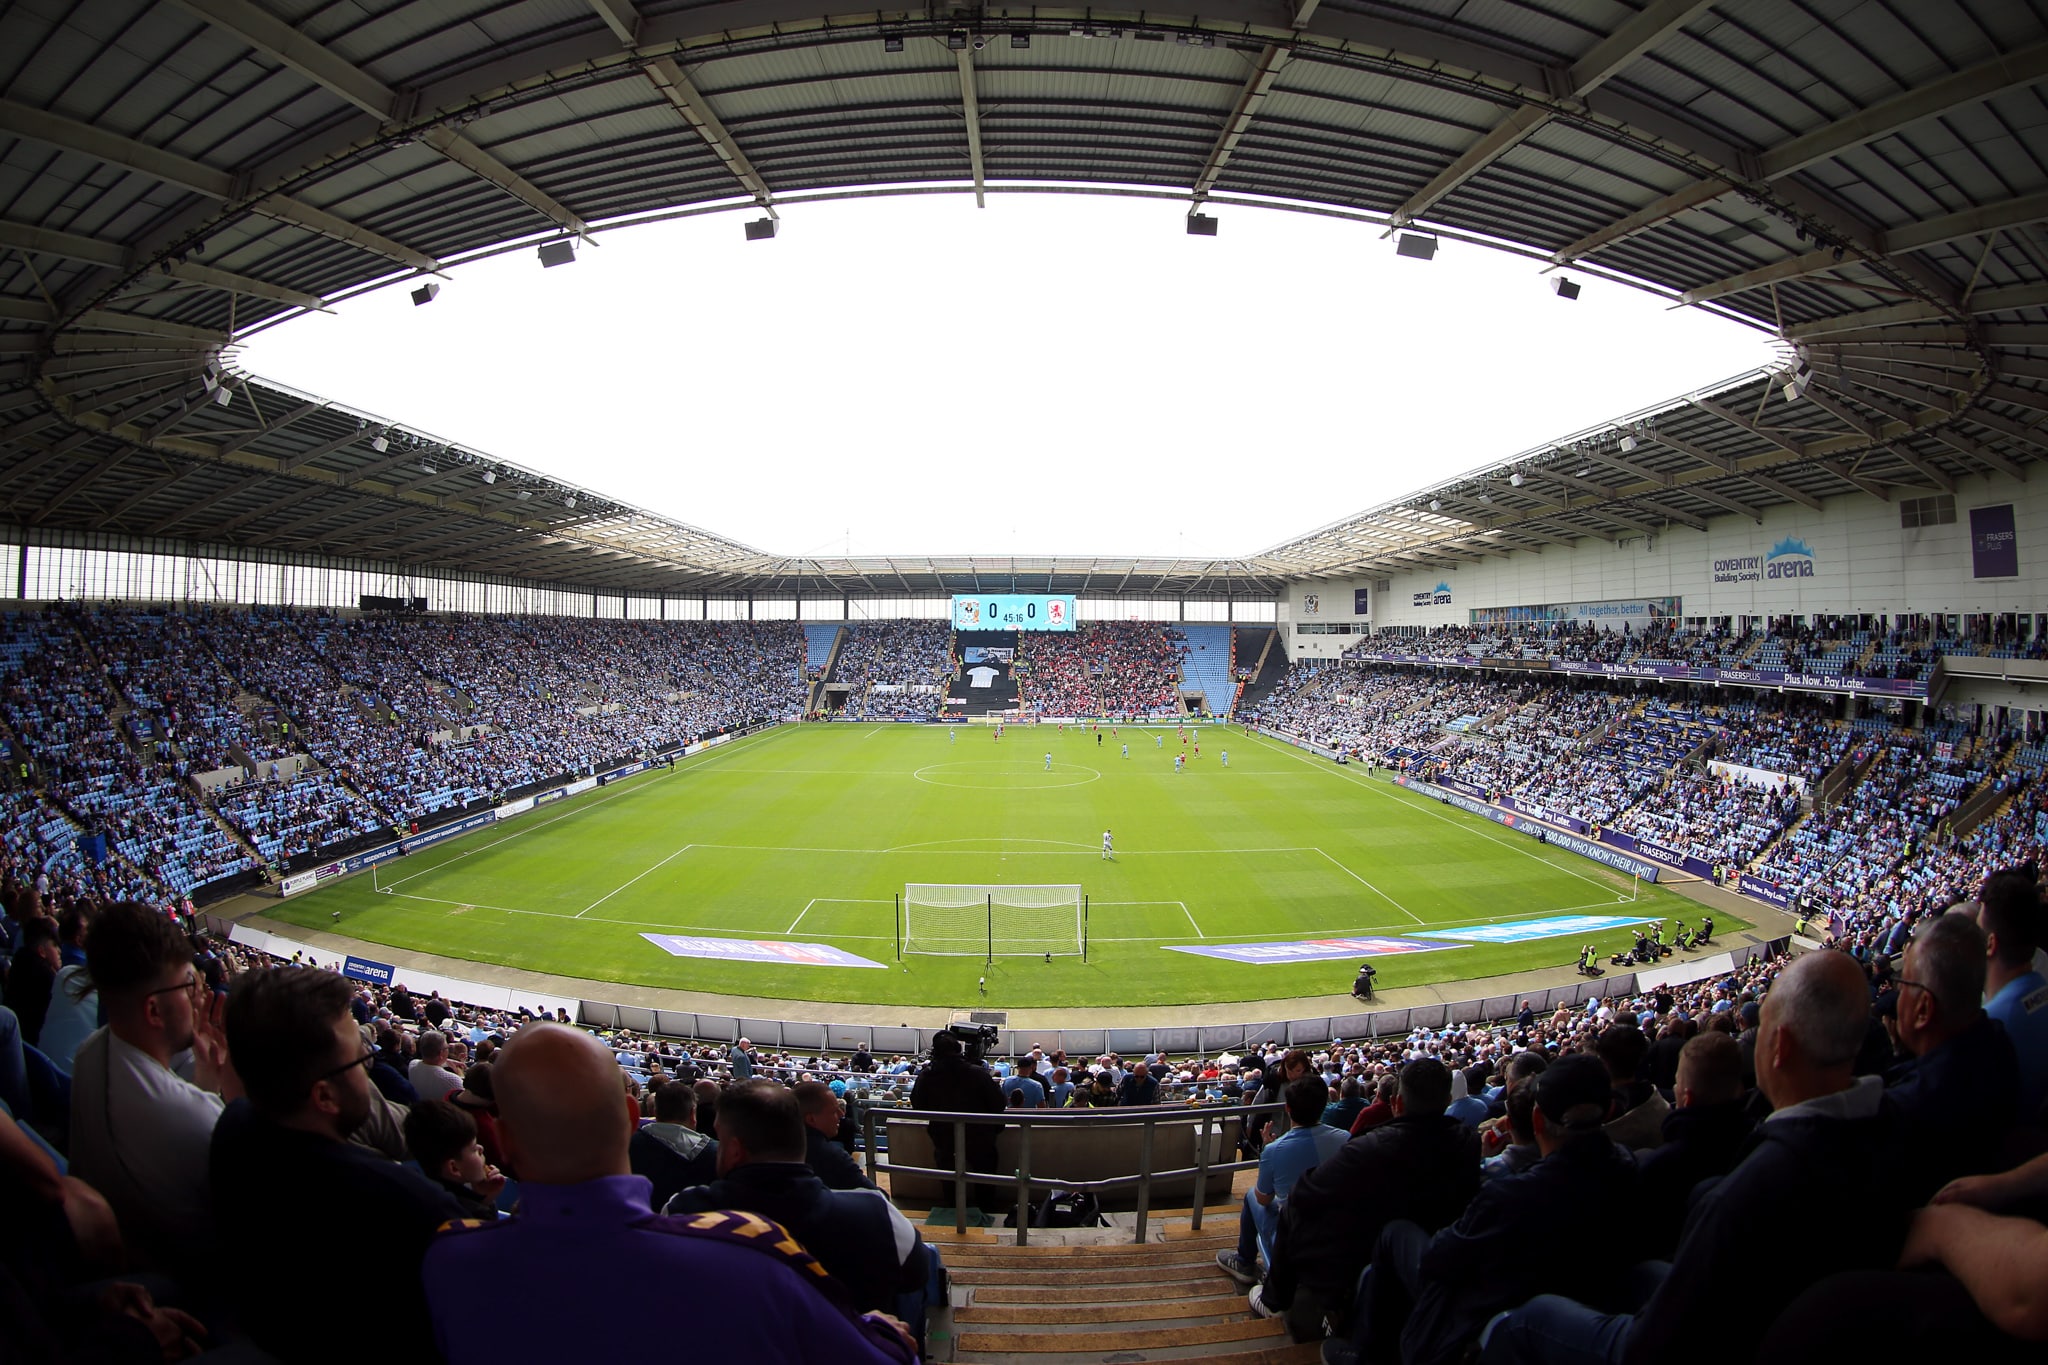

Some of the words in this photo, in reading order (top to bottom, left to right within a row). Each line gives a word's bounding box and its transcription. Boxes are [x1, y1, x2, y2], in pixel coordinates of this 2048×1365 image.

[1986, 531, 2014, 541] FRASERS
[1986, 542, 2002, 550] PLUS
[1714, 556, 1759, 572] COVENTRY
[1767, 560, 1814, 579] arena
[1714, 572, 1738, 584] Building
[1738, 572, 1760, 582] Society
[1434, 594, 1452, 604] arena
[989, 603, 998, 618] 0
[1027, 602, 1036, 618] 0
[1578, 605, 1588, 616] All
[1589, 604, 1620, 617] together,
[1621, 604, 1644, 614] better
[1003, 614, 1024, 622] 45:16
[1560, 662, 1588, 670] FRASERSPLUS
[1602, 663, 1614, 672] Plus
[1614, 664, 1628, 672] Now.
[1628, 666, 1640, 674] Pay
[1640, 666, 1657, 674] Later.
[1720, 670, 1760, 680] FRASERSPLUS
[1784, 674, 1800, 684] Plus
[1802, 675, 1822, 686] Now.
[1824, 676, 1840, 688] Pay
[1842, 677, 1866, 689] Later.
[1454, 781, 1479, 796] FRASERSPLUS
[1452, 796, 1466, 808] KNOW
[1466, 799, 1480, 812] THEIR
[1479, 805, 1492, 817] LIMIT
[1514, 800, 1526, 812] Plus
[1554, 811, 1571, 828] Later.
[424, 832, 441, 842] PROPERTY
[441, 824, 463, 837] MANAGEMENT
[473, 818, 484, 826] HOMES
[364, 851, 388, 864] RESIDENTIAL
[387, 846, 398, 857] SALES
[1519, 822, 1534, 833] JOIN
[1546, 830, 1570, 847] 500,000
[1571, 840, 1588, 854] WHO
[1588, 844, 1612, 862] KNOW
[1611, 854, 1630, 872] THEIR
[1631, 862, 1653, 878] LIMIT
[1640, 844, 1684, 867] FRASERSPLUS
[1742, 880, 1751, 890] Plus
[1751, 884, 1764, 894] Now.
[1764, 888, 1773, 899] Pay
[365, 966, 388, 979] arena
